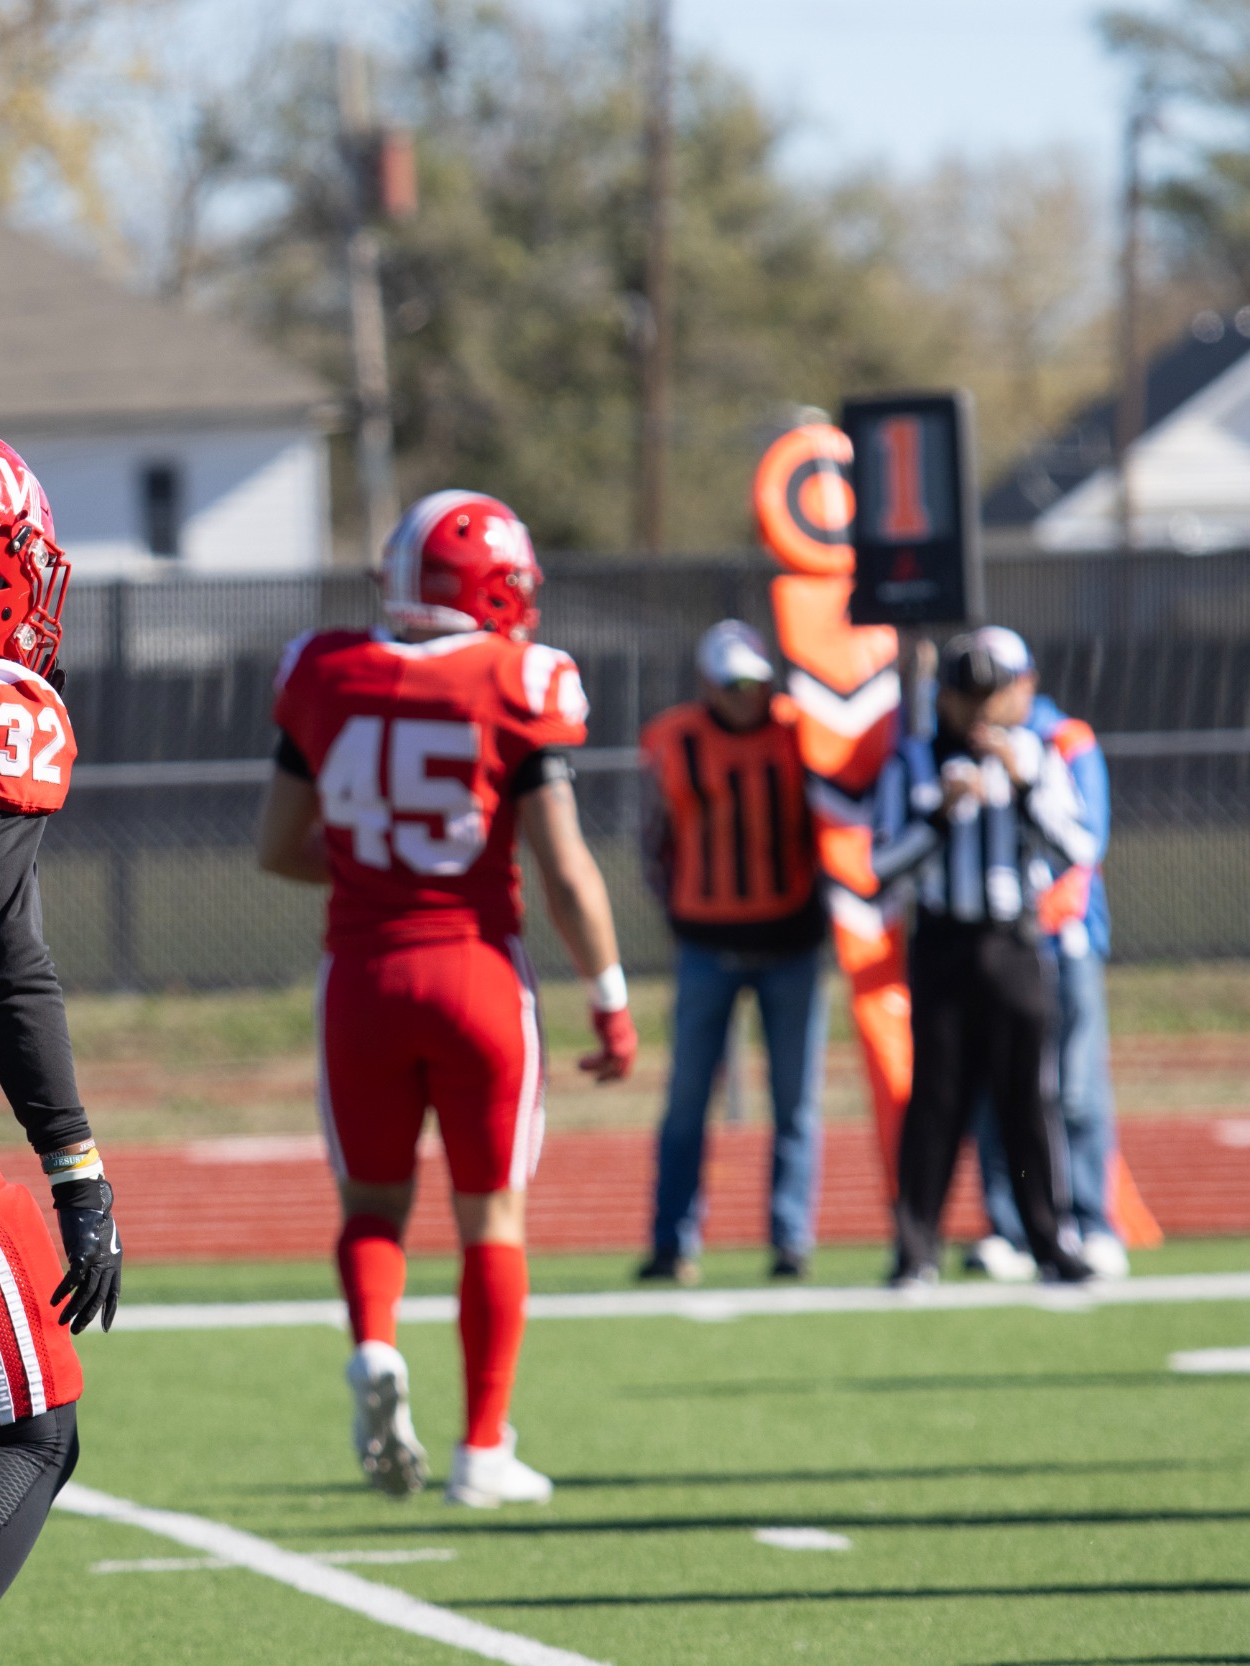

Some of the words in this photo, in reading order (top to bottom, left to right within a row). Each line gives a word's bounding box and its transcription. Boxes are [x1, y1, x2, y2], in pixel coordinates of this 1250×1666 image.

[877, 416, 932, 541] 1
[317, 714, 488, 877] 45
[53, 1155, 81, 1167] JESUS
